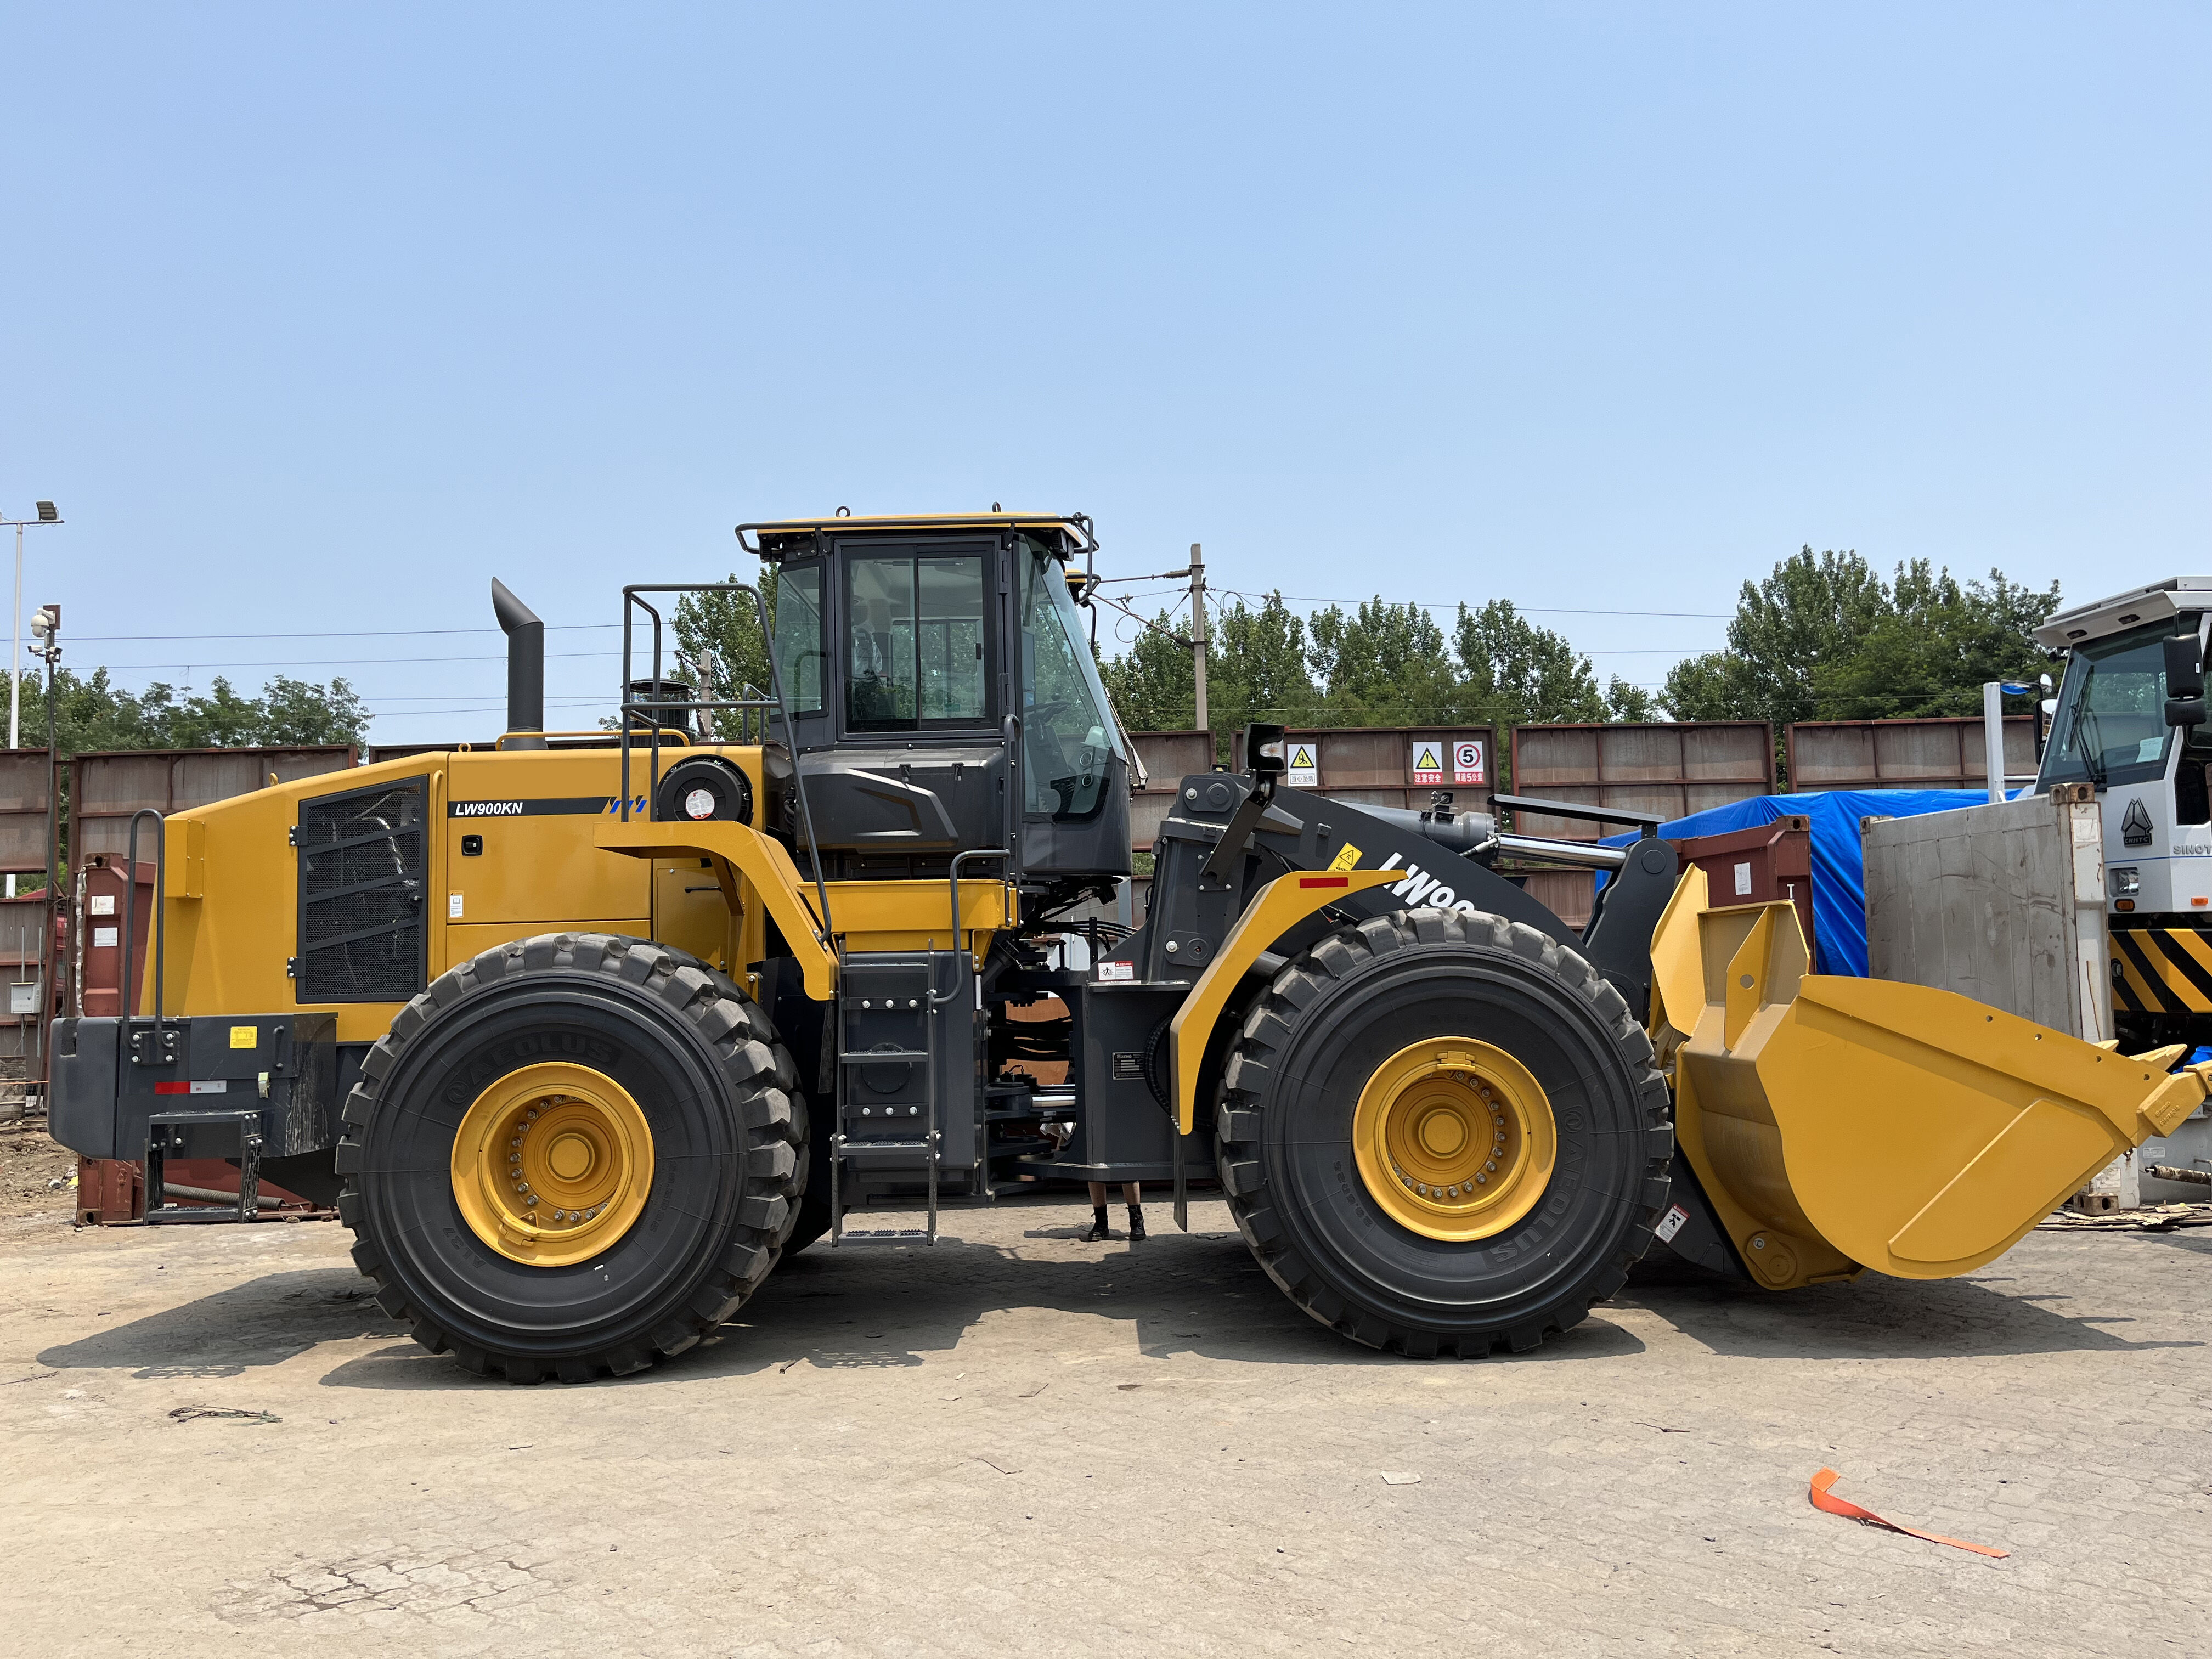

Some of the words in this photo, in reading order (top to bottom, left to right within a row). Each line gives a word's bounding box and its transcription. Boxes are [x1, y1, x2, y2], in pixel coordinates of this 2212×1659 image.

[1463, 749, 1474, 763] 5
[1415, 773, 1441, 783] 注意安全
[455, 802, 523, 815] LW900KN
[469, 1034, 613, 1085] AEOLUS
[1489, 1138, 1585, 1263] AEOLUS
[442, 1227, 487, 1269] AL37
